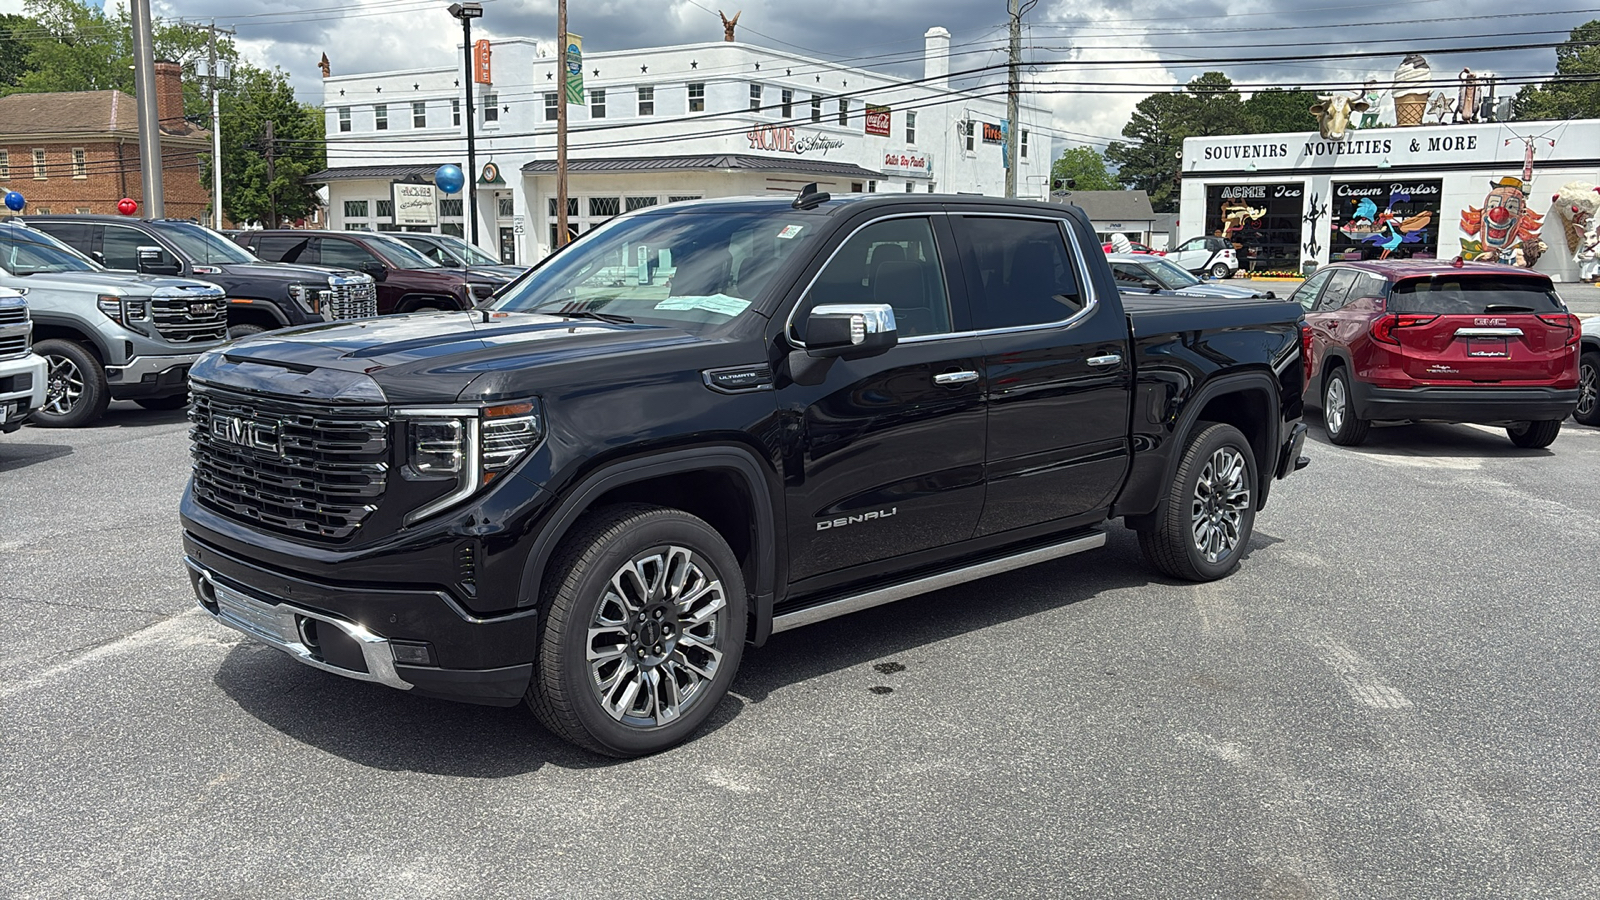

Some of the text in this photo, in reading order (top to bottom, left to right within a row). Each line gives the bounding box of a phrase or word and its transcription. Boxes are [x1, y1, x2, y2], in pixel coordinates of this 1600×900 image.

[481, 42, 489, 80] ACME
[747, 122, 845, 156] ACME Antiques
[1204, 135, 1478, 160] SOUVENIRS NOVELTIES & MORE
[1221, 185, 1302, 198] ACME Ice
[1337, 182, 1439, 197] Cream Parlor
[514, 225, 524, 233] 25
[1474, 318, 1507, 326] GMC
[718, 372, 756, 380] ULTIMATE
[210, 413, 279, 454] GMC
[816, 507, 897, 531] DENALI
